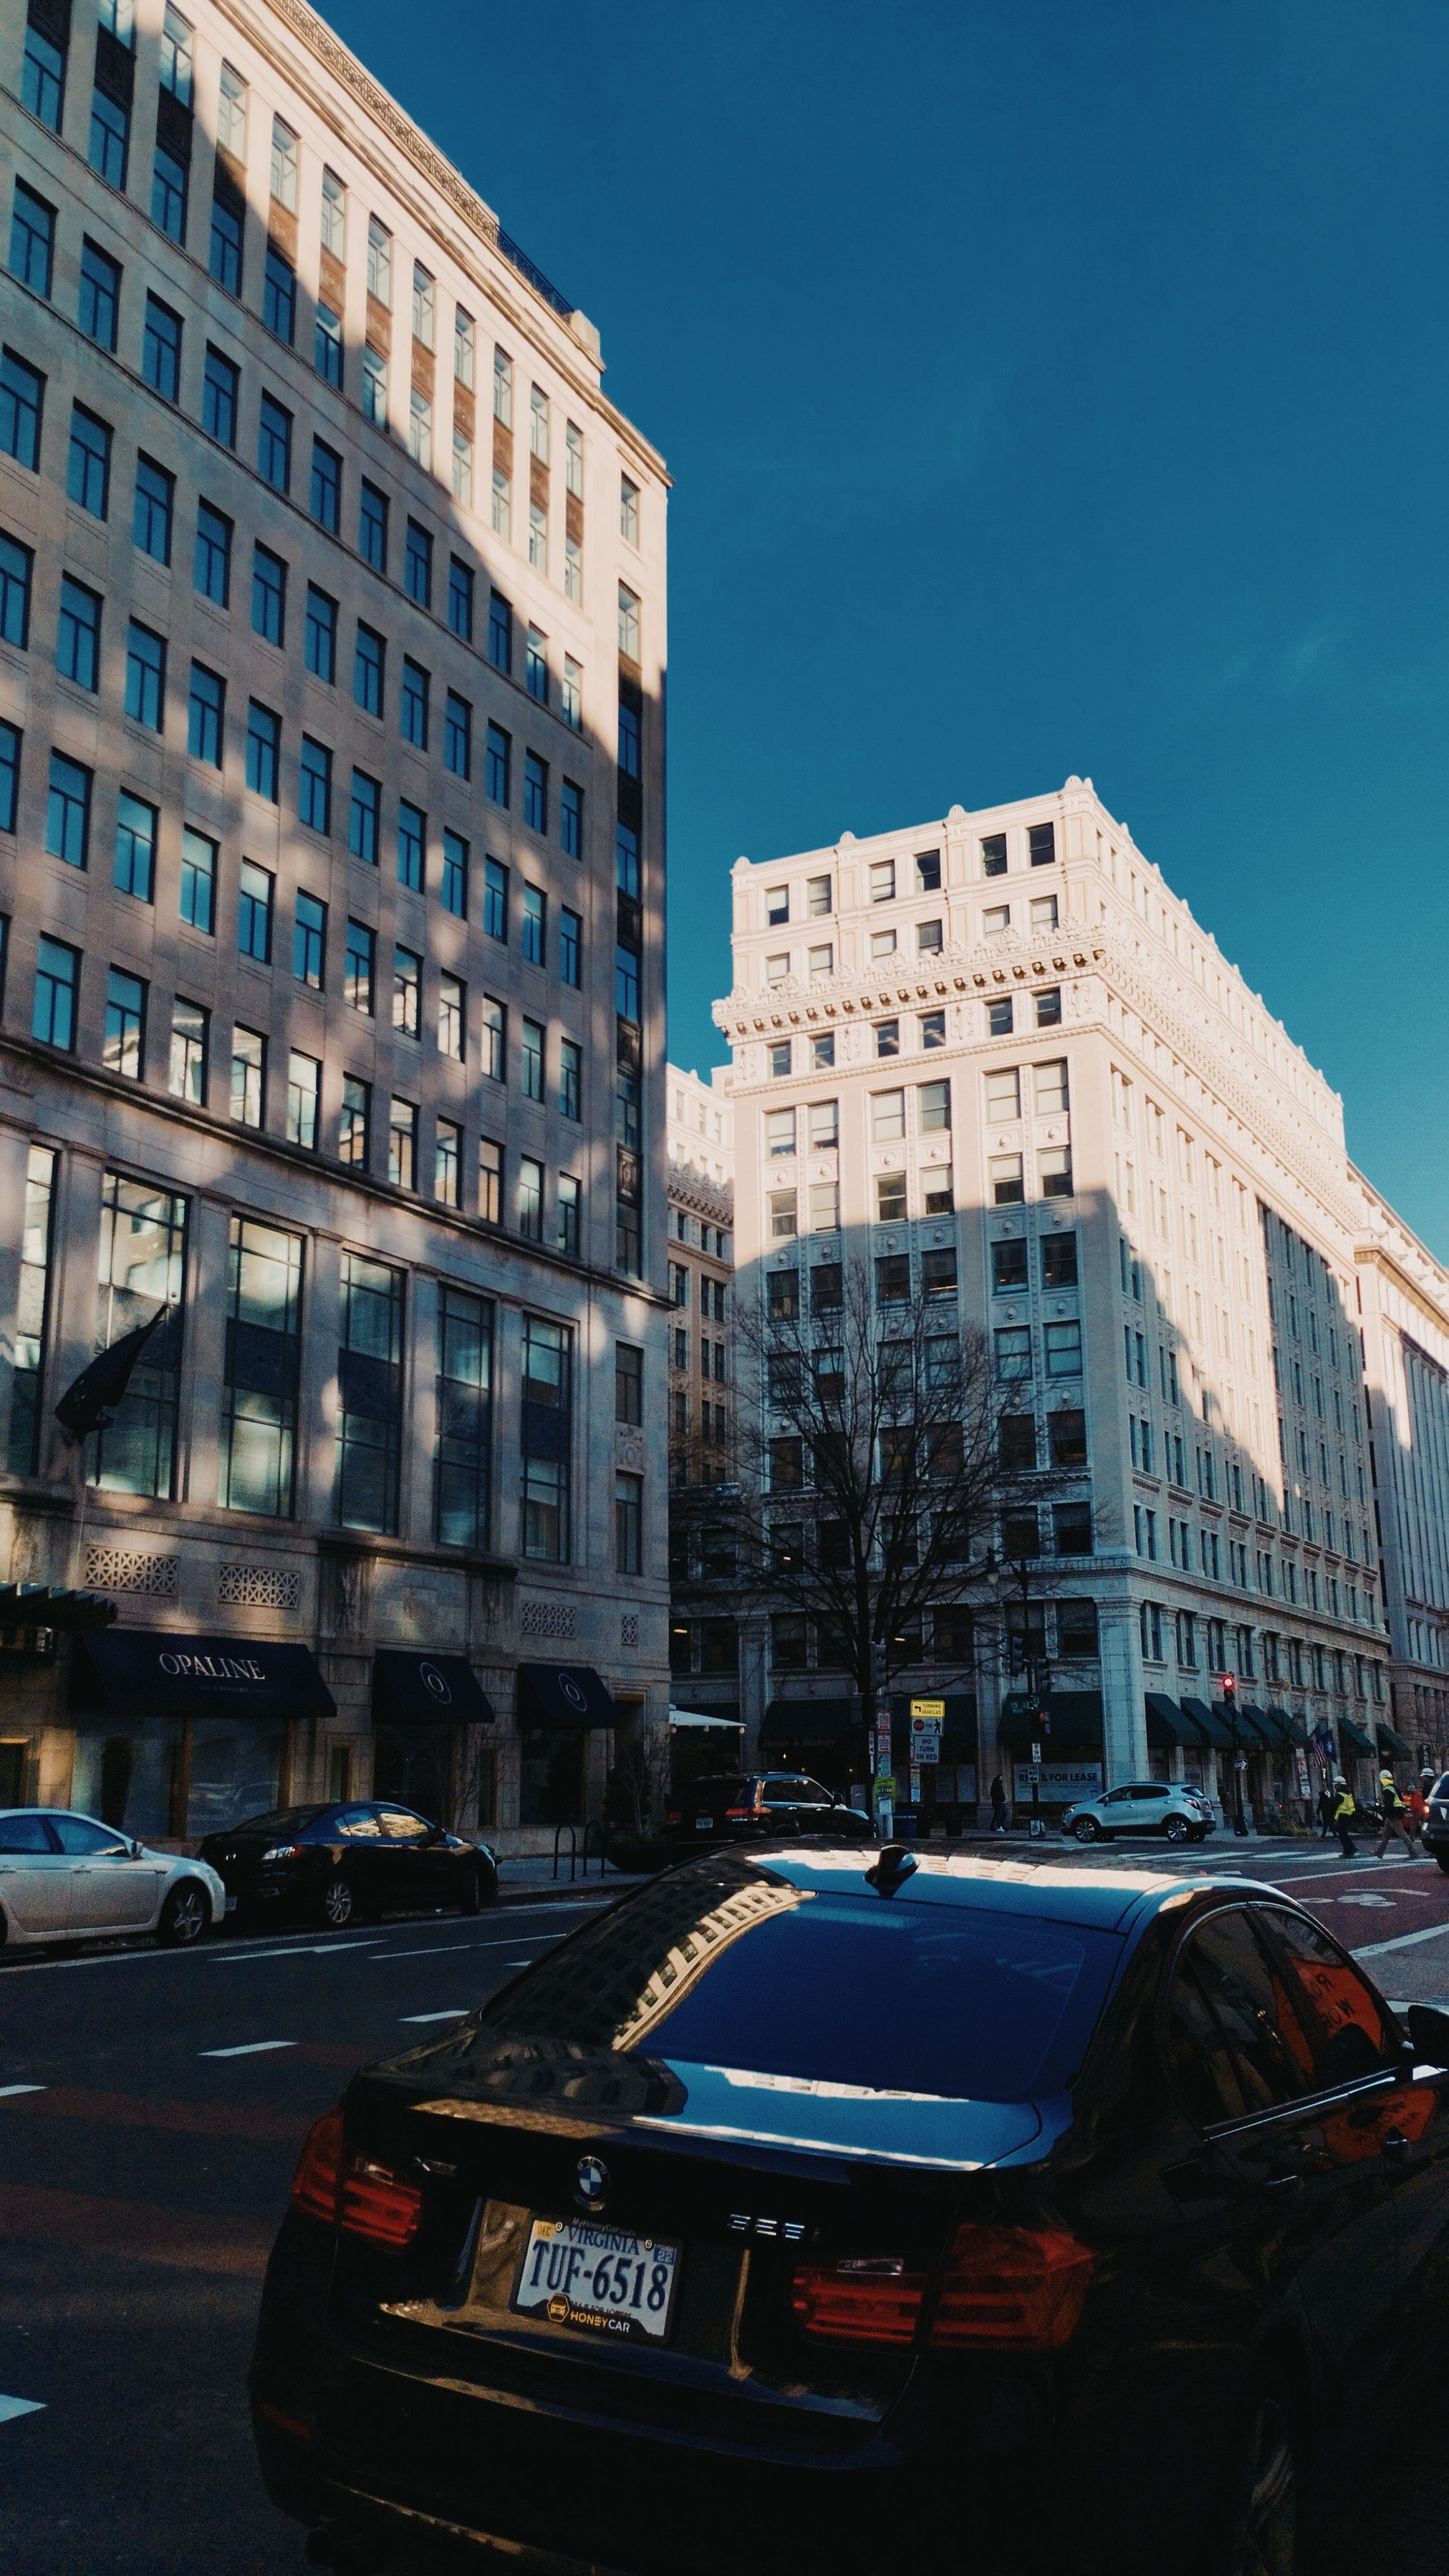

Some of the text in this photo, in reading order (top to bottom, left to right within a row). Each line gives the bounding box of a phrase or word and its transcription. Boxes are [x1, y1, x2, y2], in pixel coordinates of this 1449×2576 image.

[158, 1653, 267, 1680] OPALINE
[1070, 1773, 1097, 1781] LEASE
[572, 2217, 637, 2237] MyHoneyCar.com
[569, 2226, 640, 2255] VIRGINIA
[658, 2250, 674, 2263] 22
[529, 2239, 668, 2311] TUF-6518
[569, 2310, 630, 2333] HONEYCAR
